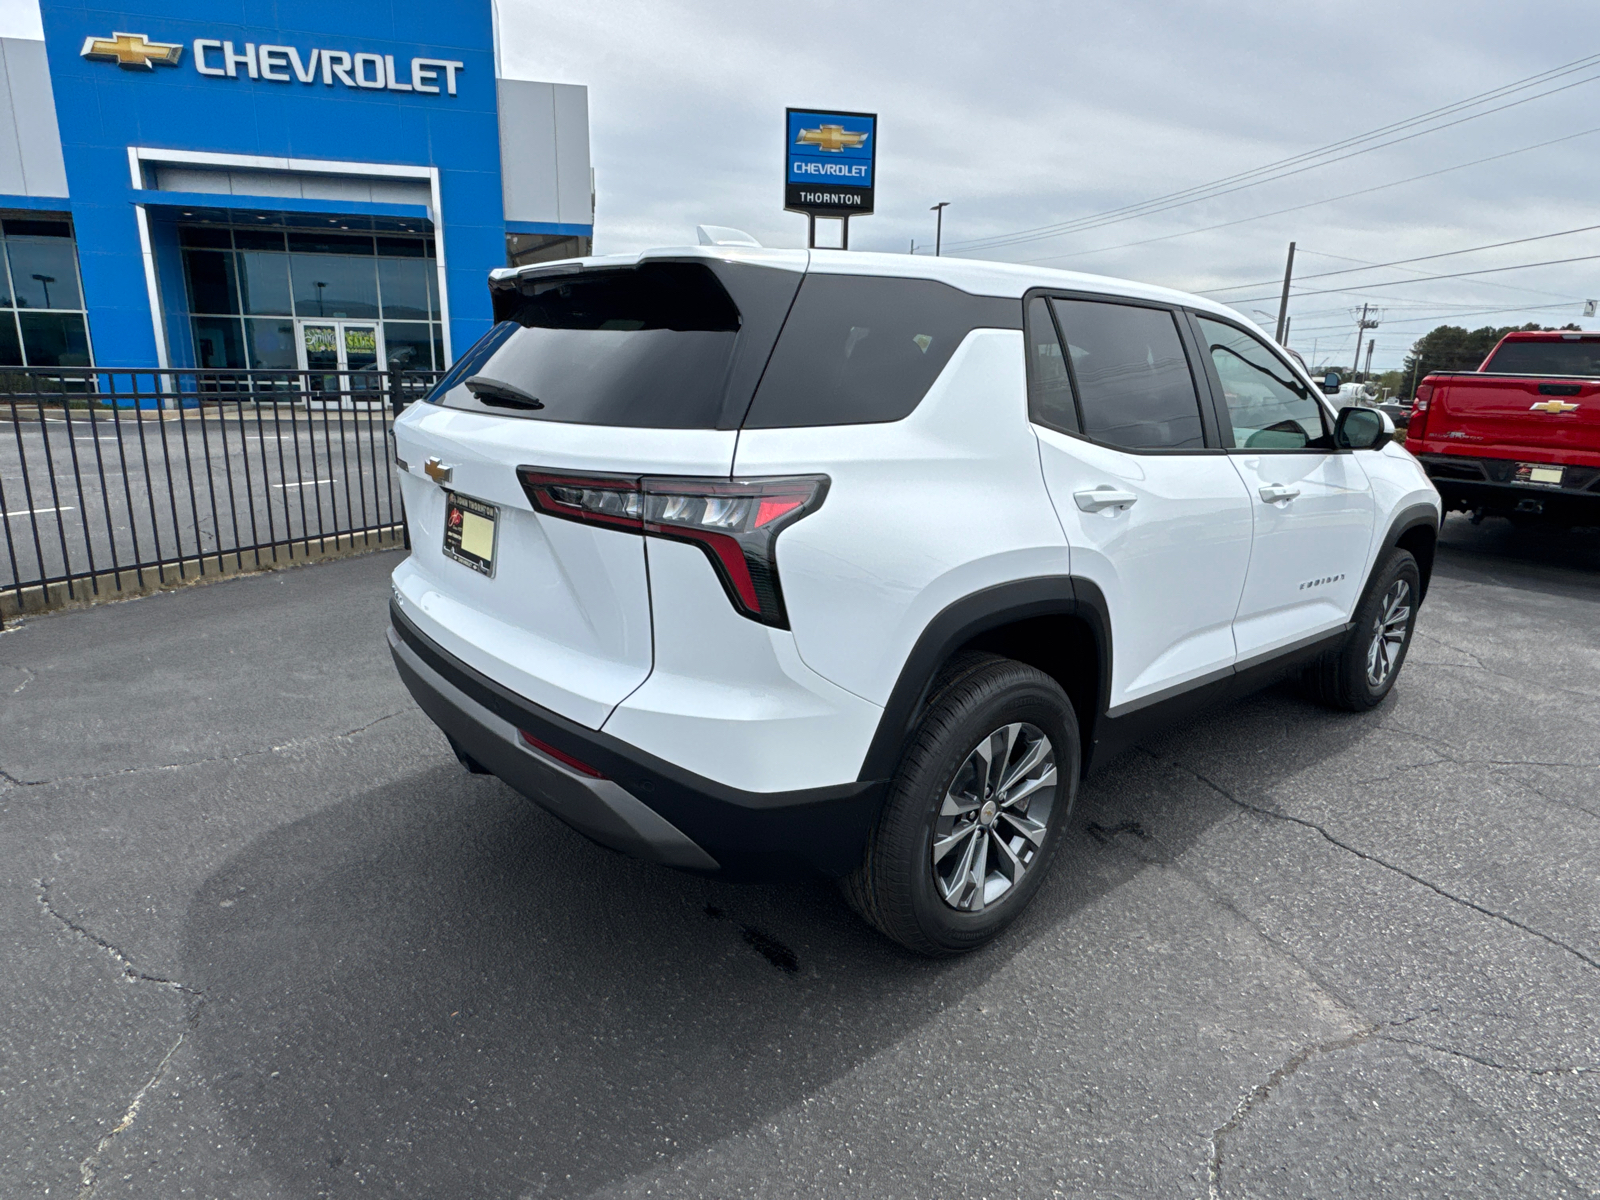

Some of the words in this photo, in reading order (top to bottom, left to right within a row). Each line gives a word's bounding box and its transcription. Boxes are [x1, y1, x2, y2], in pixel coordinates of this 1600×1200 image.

[194, 39, 463, 95] CHEVROLET
[794, 162, 867, 177] CHEVROLET
[800, 192, 861, 205] THORNTON
